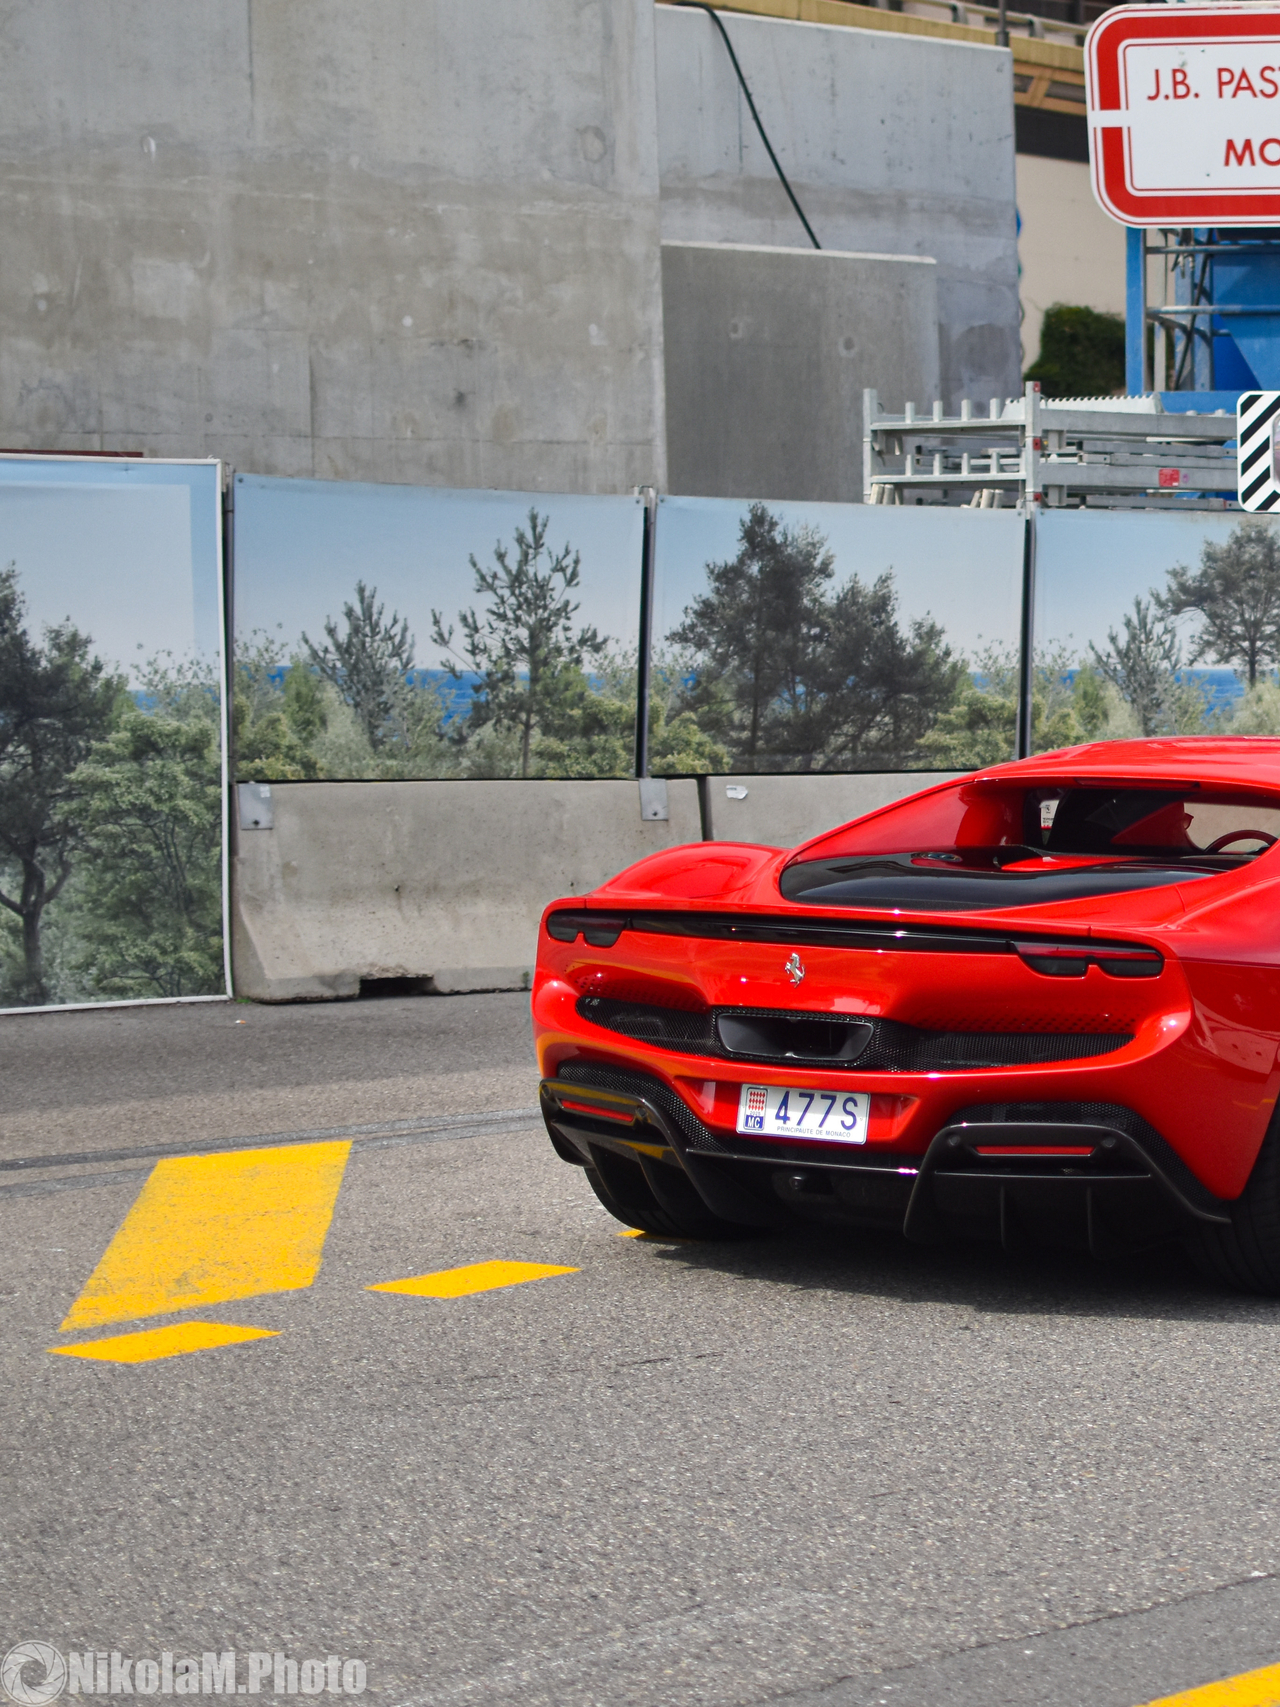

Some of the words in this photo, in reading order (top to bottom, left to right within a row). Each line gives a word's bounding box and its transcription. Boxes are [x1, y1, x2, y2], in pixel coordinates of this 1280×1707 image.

[1147, 68, 1200, 100] J.B.
[774, 1090, 858, 1131] 477S
[747, 1117, 761, 1129] MC
[825, 1130, 851, 1138] MONACO
